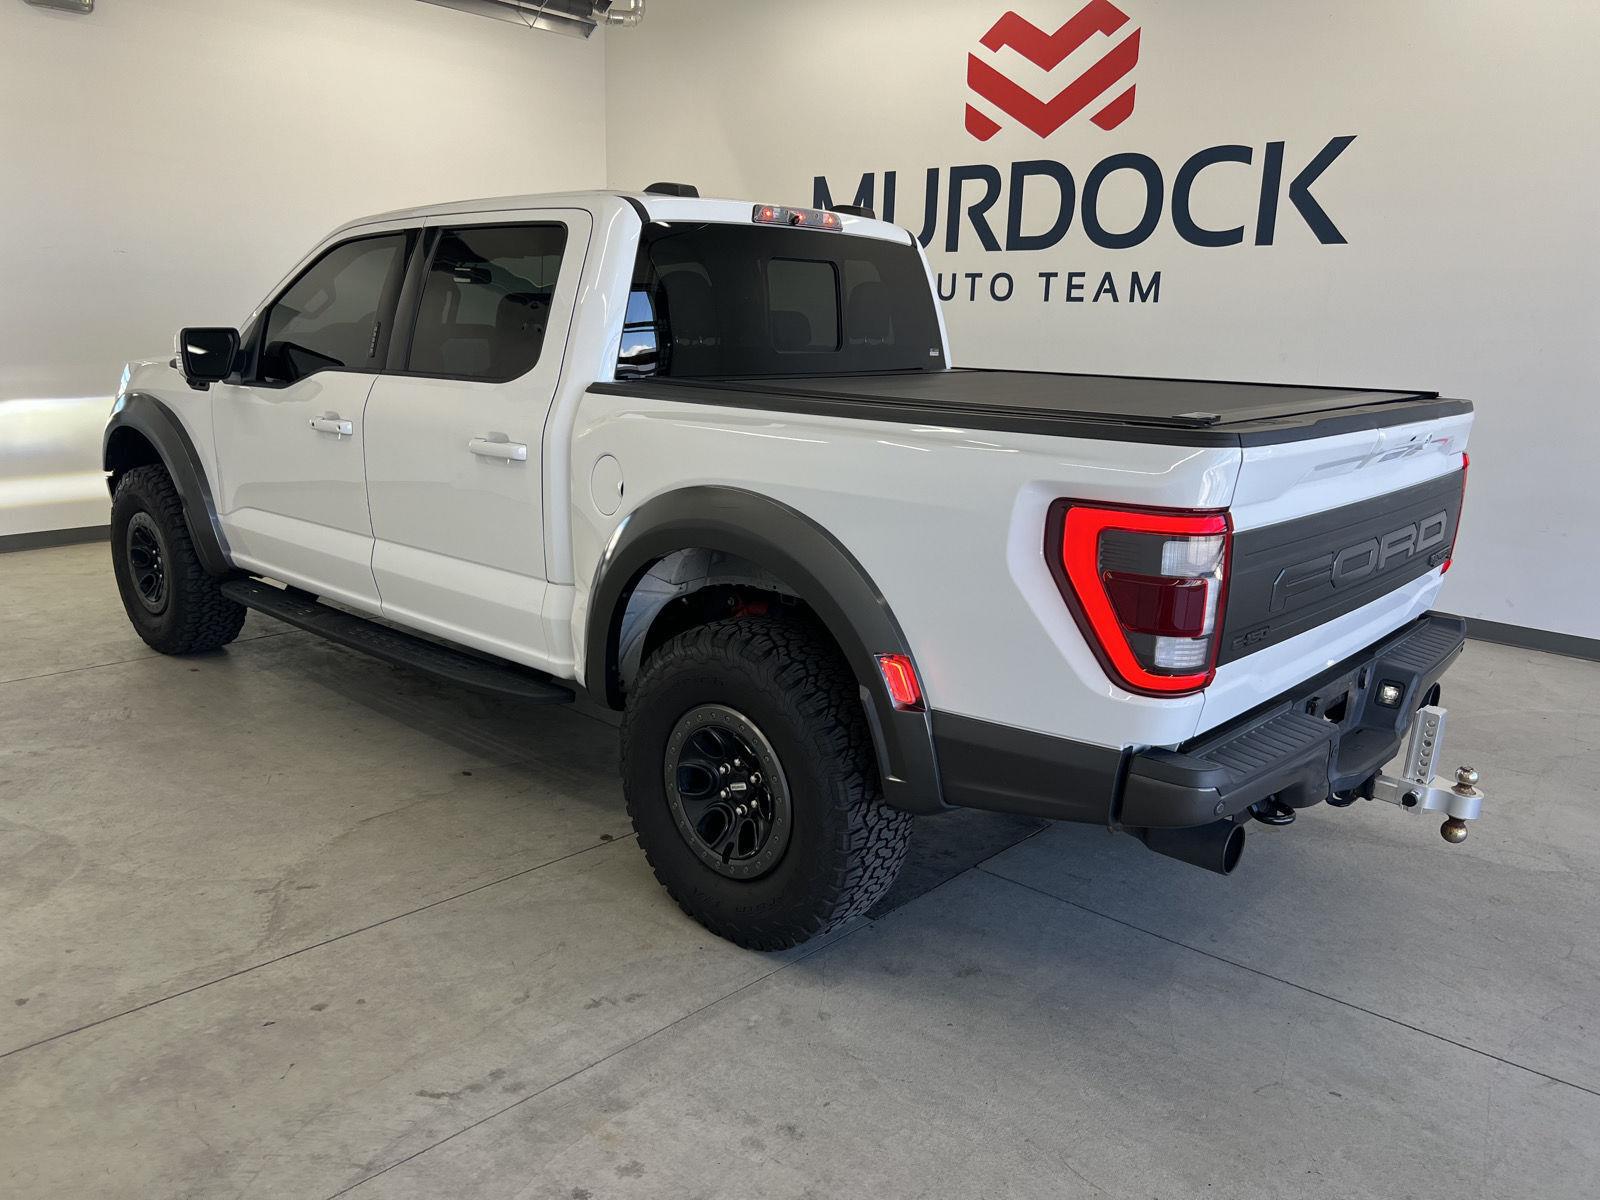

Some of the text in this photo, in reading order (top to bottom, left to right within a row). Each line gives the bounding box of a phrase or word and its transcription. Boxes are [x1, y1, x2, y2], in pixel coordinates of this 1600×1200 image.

[937, 270, 1162, 304] UTO TEAM
[1268, 508, 1448, 613] FORD
